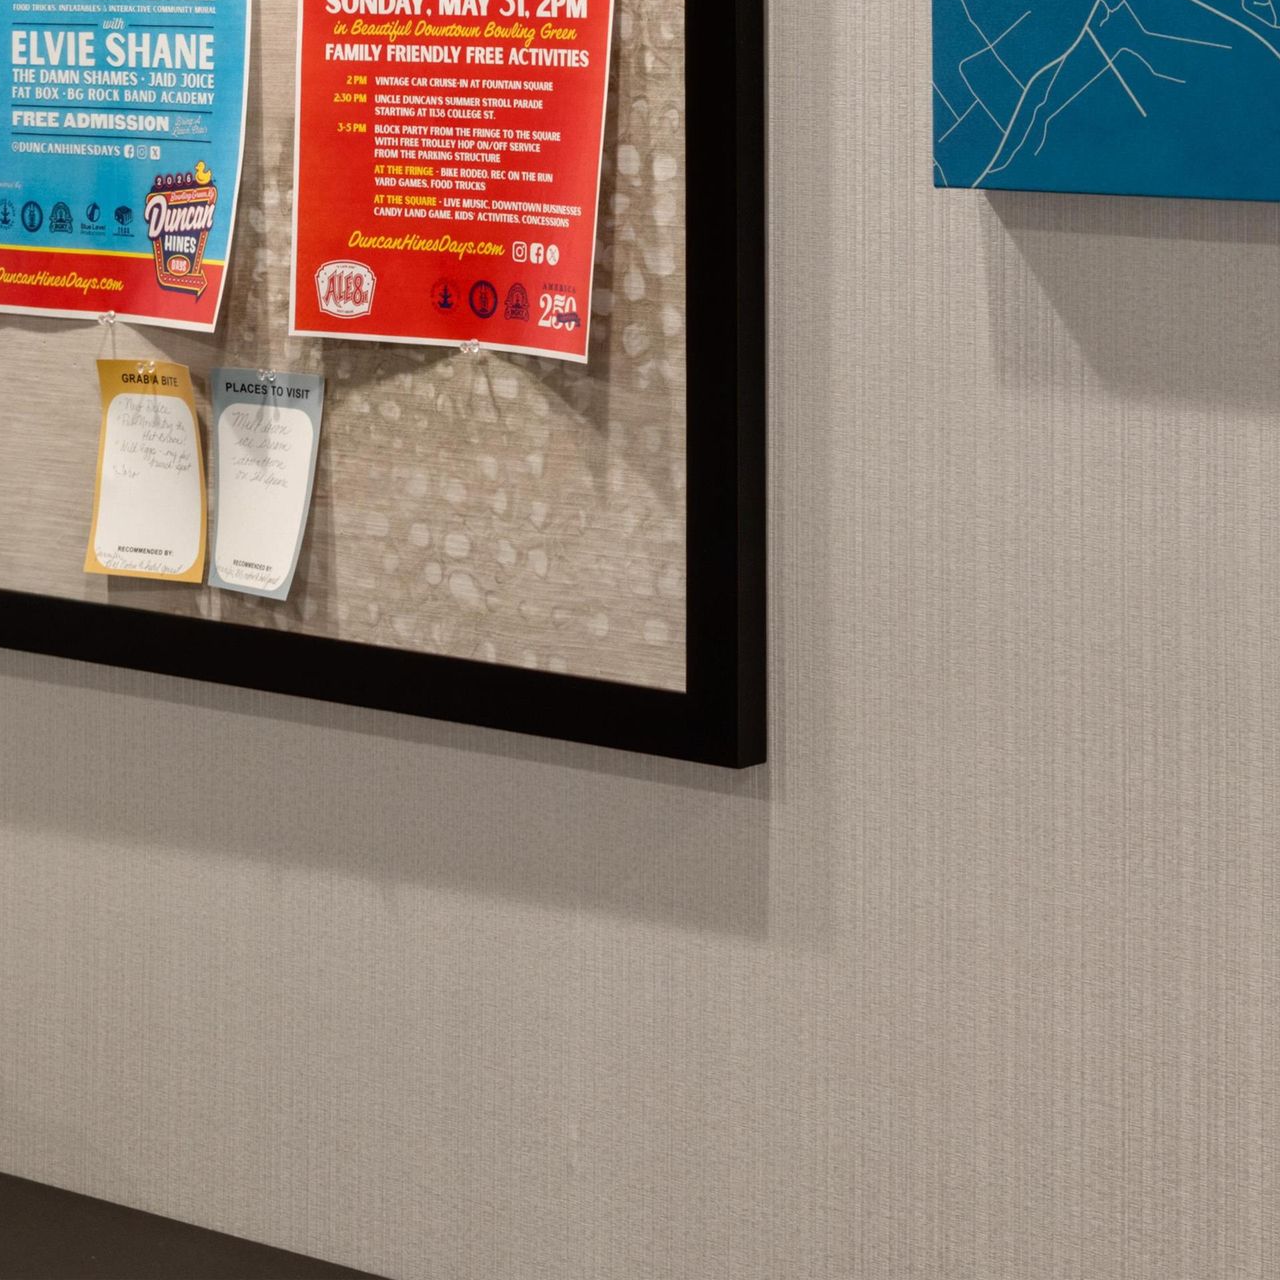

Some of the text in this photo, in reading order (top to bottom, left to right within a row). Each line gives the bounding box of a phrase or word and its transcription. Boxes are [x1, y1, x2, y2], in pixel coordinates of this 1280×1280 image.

[103, 18, 125, 29] with
[334, 19, 577, 47] in Beautiful Downtown Bowling Green
[11, 31, 215, 70] ELVIE SHANE
[325, 44, 589, 68] FAMILY FRIENDLY FREE ACTIVITIES
[13, 69, 215, 89] THE DAMN SHAMES JAID JOICE
[346, 76, 367, 85] 2 PM
[375, 77, 553, 91] VINTAGE CAR CRUISE-IN AT FOUNTAIN SQUARE
[12, 87, 215, 104] FAT BOX BG ROCK BAND ACADEMY
[375, 95, 543, 109] UNCLE DUNCAN'S SUMMER STROLL PARADE
[375, 107, 415, 117] STARTING
[417, 108, 427, 117] AT
[429, 108, 445, 117] 1138
[447, 109, 481, 119] COLLEGE
[12, 111, 59, 127] FREE
[64, 113, 169, 132] ADMISSION
[337, 123, 367, 132] 3-5 PM
[375, 125, 561, 141] BLOCK PARTY FROM THE FRINGE TO THE SQUARE
[12, 142, 120, 157] @DUNCANHINESDAYS
[375, 137, 541, 152] WITH FREE TROLLEY HOP ON/OFF SERVICE
[374, 149, 501, 163] FROM THE PARKING STRUCTURE
[155, 174, 194, 186] 2026
[145, 194, 216, 239] Duncan
[165, 235, 197, 253] HINES
[348, 231, 505, 261] DuncanHinesDays.com
[121, 374, 178, 387] GRAB A BITE
[225, 383, 310, 399] PLACES TO VISIT
[118, 545, 162, 556] RECOMMENDED
